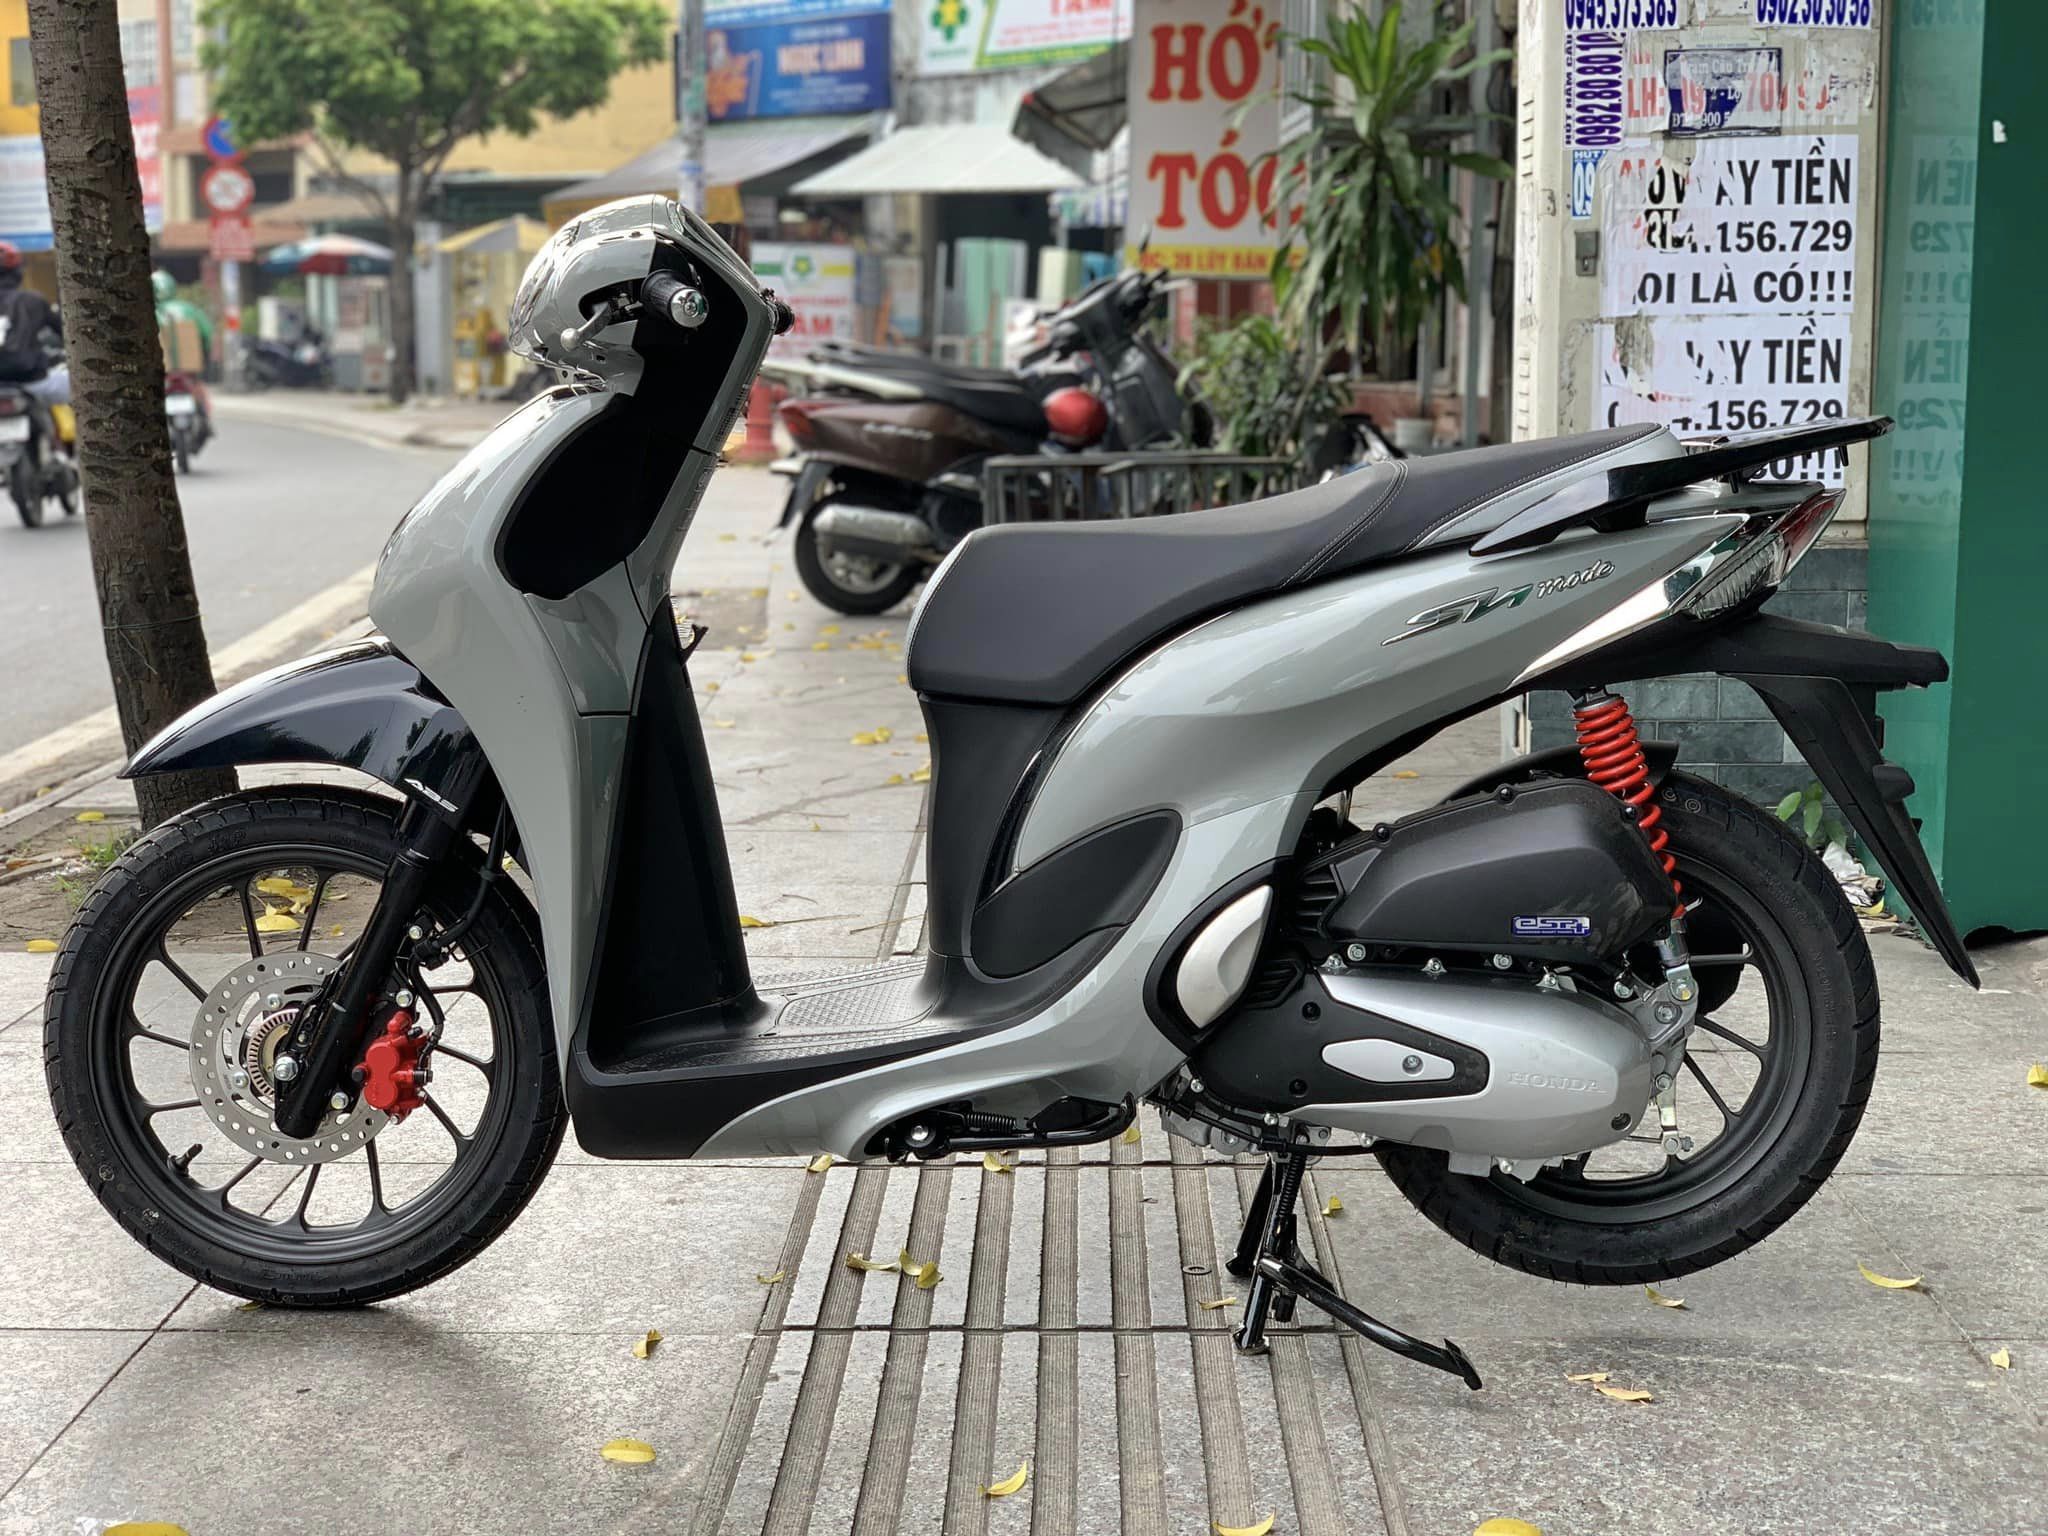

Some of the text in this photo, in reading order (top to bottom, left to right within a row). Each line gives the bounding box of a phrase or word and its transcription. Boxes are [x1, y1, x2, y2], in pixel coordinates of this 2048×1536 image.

[1147, 0, 1281, 102] HỚ
[1627, 76, 1665, 118] LH:
[1772, 137, 1851, 205] TIỀN
[1691, 263, 1738, 303] LÀ
[1753, 262, 1852, 303] CÓ!!!
[1763, 318, 1842, 384] TIỀN
[1537, 560, 1616, 599] mode
[1507, 1071, 1608, 1095] HONDA
